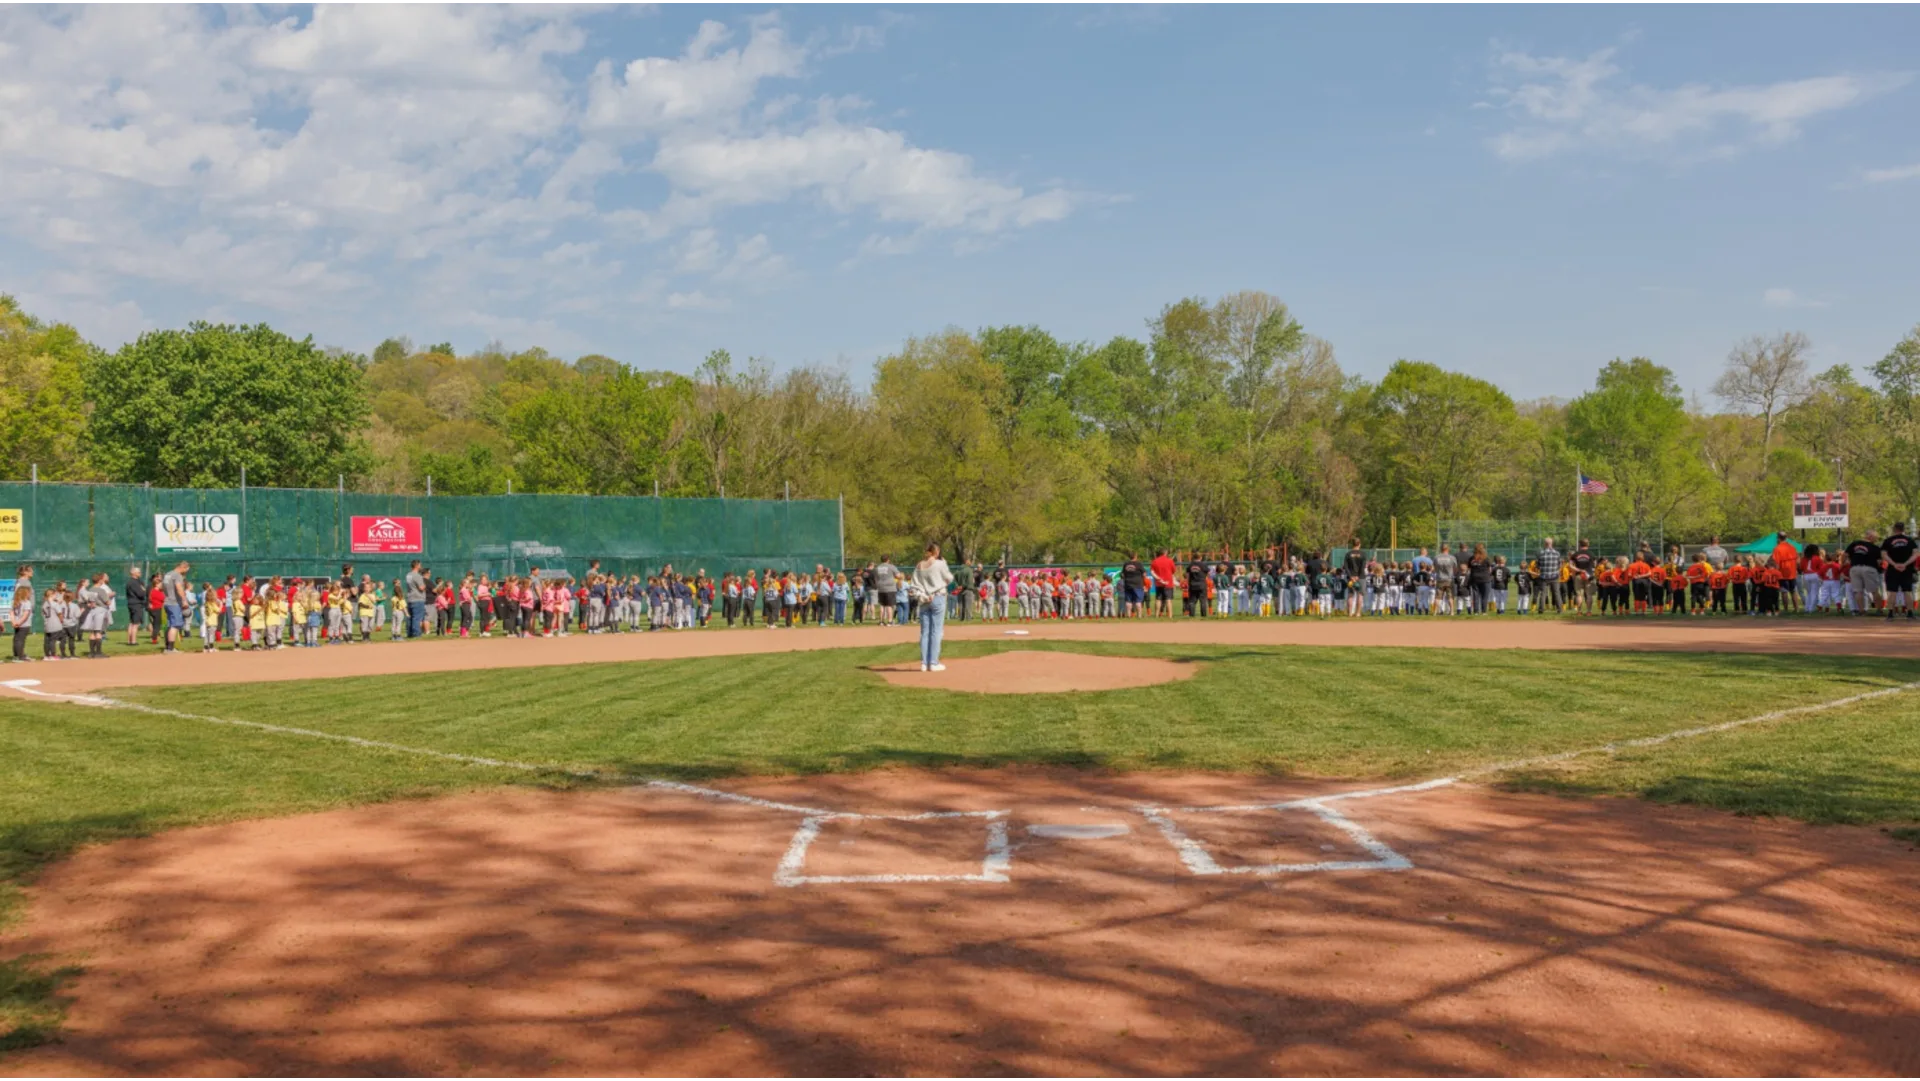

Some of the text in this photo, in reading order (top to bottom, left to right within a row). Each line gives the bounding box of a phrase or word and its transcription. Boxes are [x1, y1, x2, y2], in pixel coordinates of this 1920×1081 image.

[162, 515, 225, 534] OHIO
[368, 528, 406, 539] KASLER
[1825, 567, 1834, 579] 4
